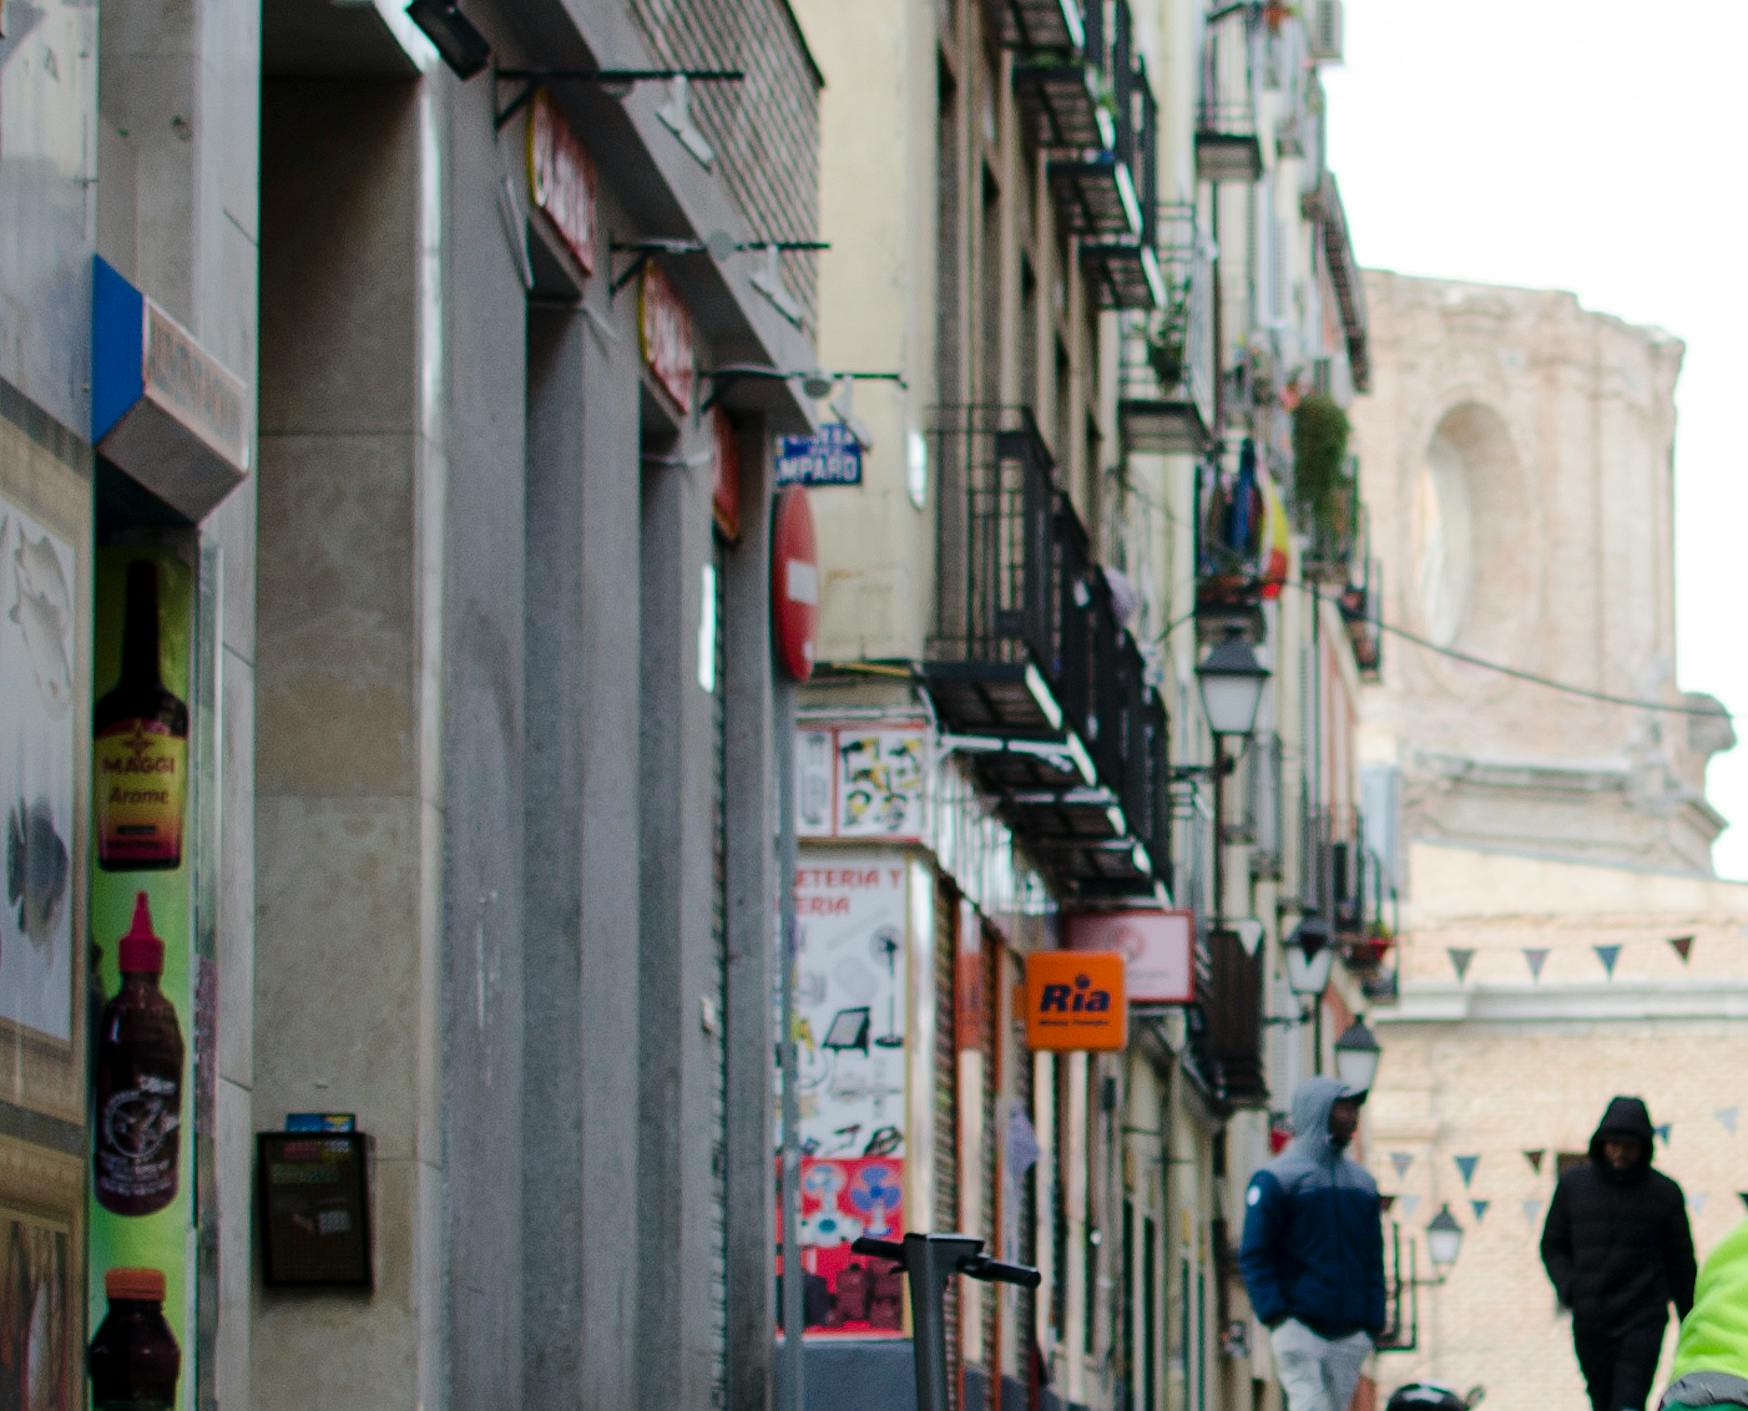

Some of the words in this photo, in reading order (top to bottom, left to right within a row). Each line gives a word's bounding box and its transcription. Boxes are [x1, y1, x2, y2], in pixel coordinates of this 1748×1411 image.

[776, 455, 858, 481] MPARO
[103, 757, 175, 774] MAGGI
[796, 868, 879, 888] ETERIA
[1039, 974, 1110, 1012] Ria
